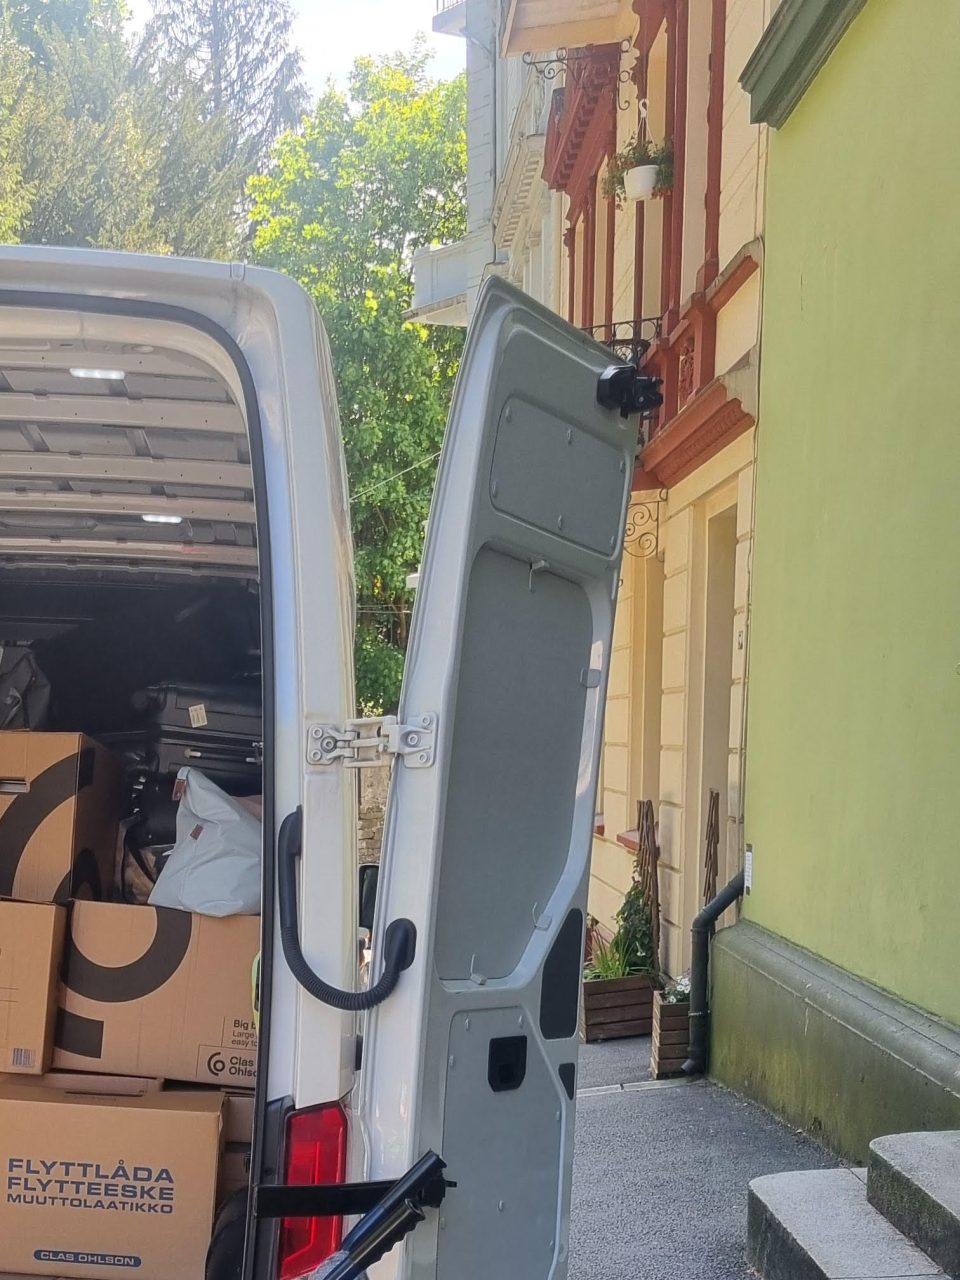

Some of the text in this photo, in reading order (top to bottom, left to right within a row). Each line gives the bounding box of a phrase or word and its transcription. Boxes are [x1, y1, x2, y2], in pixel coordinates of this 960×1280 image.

[233, 1019, 249, 1030] Big
[229, 1056, 254, 1067] Clas
[228, 1066, 257, 1078] Ohls
[8, 1158, 175, 1184] FLYTTLÅDA
[7, 1176, 174, 1201] FLYTTEESKE
[6, 1193, 173, 1214] MUUTTOLAATIKKO
[40, 1251, 135, 1265] CLAS OHLSON
